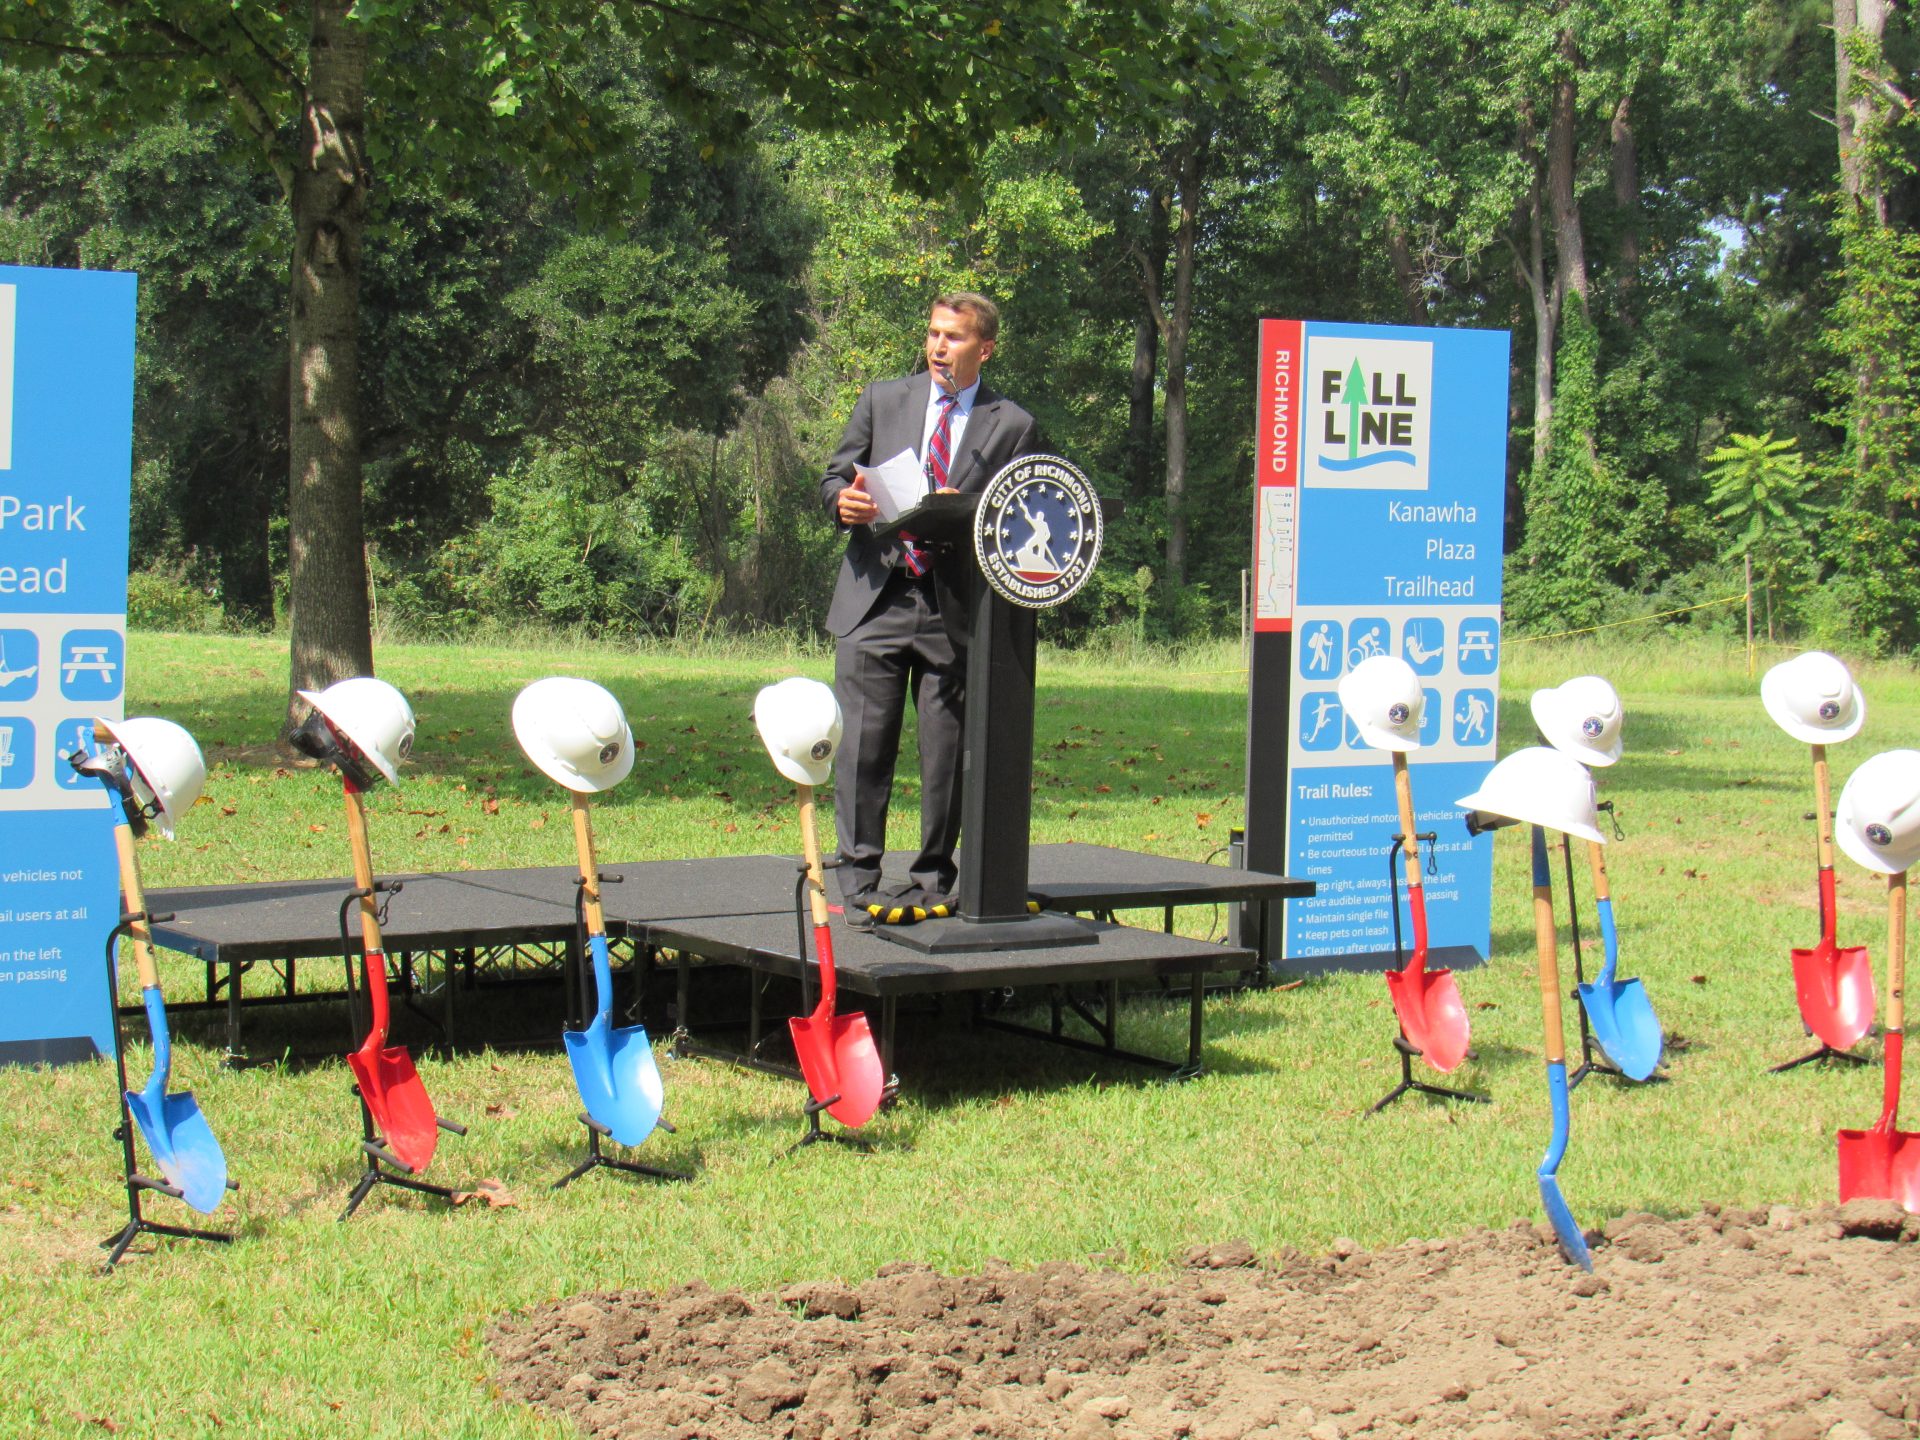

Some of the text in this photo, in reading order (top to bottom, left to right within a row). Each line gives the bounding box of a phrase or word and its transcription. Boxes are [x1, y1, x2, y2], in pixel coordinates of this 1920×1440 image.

[1272, 351, 1290, 472] RICHMOND
[991, 464, 1092, 514] CITY OF RICHMOND
[0, 495, 87, 531] Park
[1389, 501, 1476, 523] Kanawha
[1426, 539, 1476, 560] Plaza
[988, 552, 1086, 599] ESTABLISHED 1737
[1384, 576, 1475, 598] Trailhead
[1298, 783, 1373, 799] Trail Rules:
[1308, 814, 1369, 826] Unauthorized
[1417, 810, 1453, 821] vehicles
[1308, 831, 1353, 845] permitted
[1450, 842, 1461, 851] at
[1461, 840, 1472, 850] all
[1307, 849, 1320, 859] Be
[1321, 847, 1367, 858] courteous
[1369, 846, 1379, 856] to
[2, 869, 83, 882] vehicles not
[1307, 865, 1333, 876] times
[1356, 879, 1387, 890] always
[1423, 875, 1439, 884] the
[1440, 873, 1456, 883] left
[1306, 898, 1327, 908] Give
[1328, 895, 1361, 906] audible
[1425, 890, 1459, 902] passing
[16, 911, 53, 921] users
[55, 908, 69, 920] at
[71, 907, 88, 920] all
[1306, 909, 1389, 924] Maintain single file
[1305, 926, 1389, 941] Keep pets on leash
[13, 948, 36, 961] the
[39, 947, 62, 960] left
[1305, 945, 1331, 956] Clean
[1332, 945, 1344, 956] up
[1346, 943, 1370, 953] after
[1369, 942, 1389, 953] your
[17, 967, 68, 983] passing
